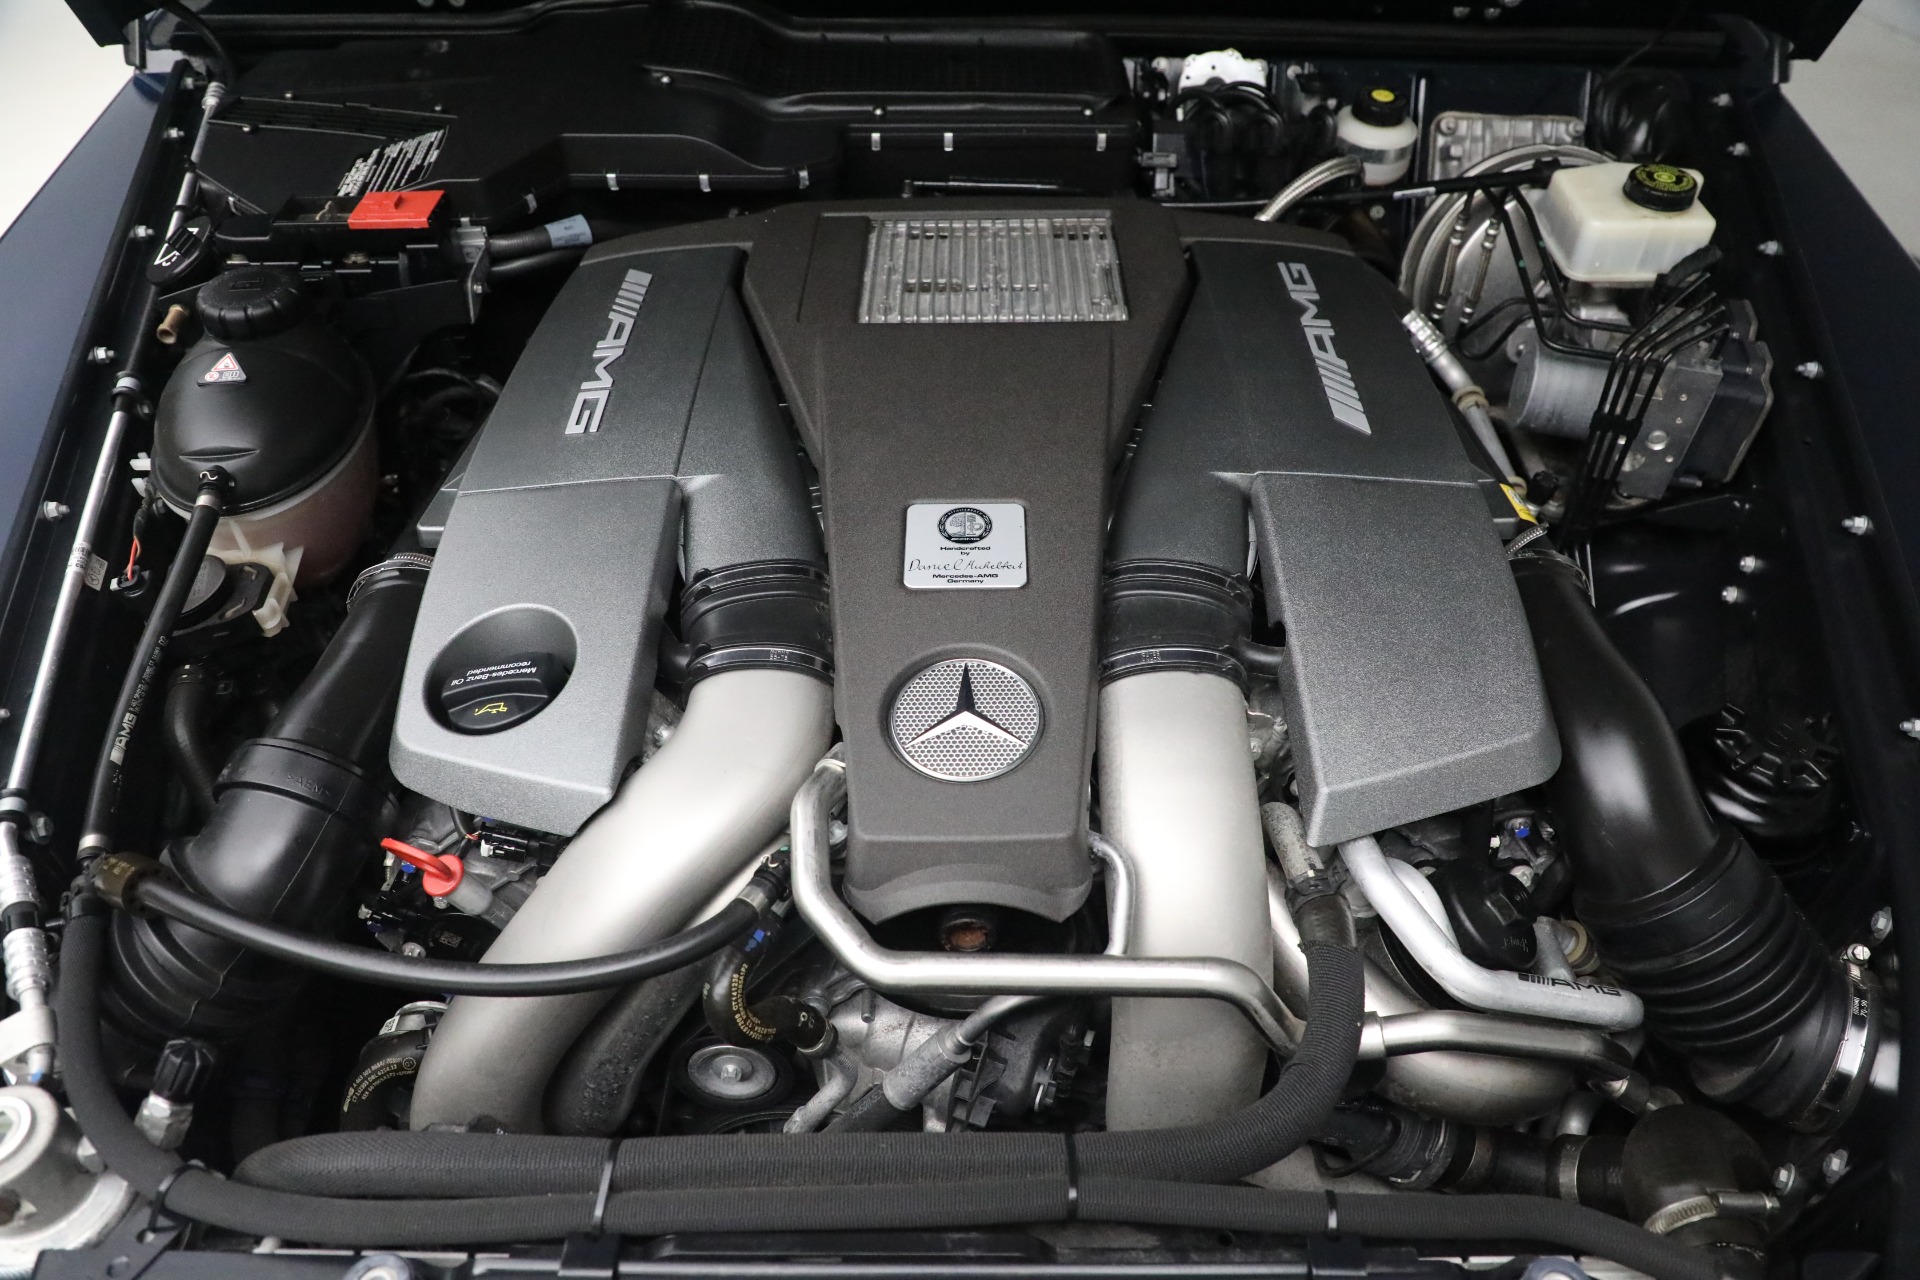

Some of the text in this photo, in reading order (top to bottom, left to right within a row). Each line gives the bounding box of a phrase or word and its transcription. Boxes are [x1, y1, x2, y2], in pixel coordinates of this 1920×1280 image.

[1277, 262, 1348, 370] AMG
[565, 311, 635, 434] AMG
[451, 667, 537, 686] Mercedes-Benz Oil
[467, 661, 531, 676] recommended
